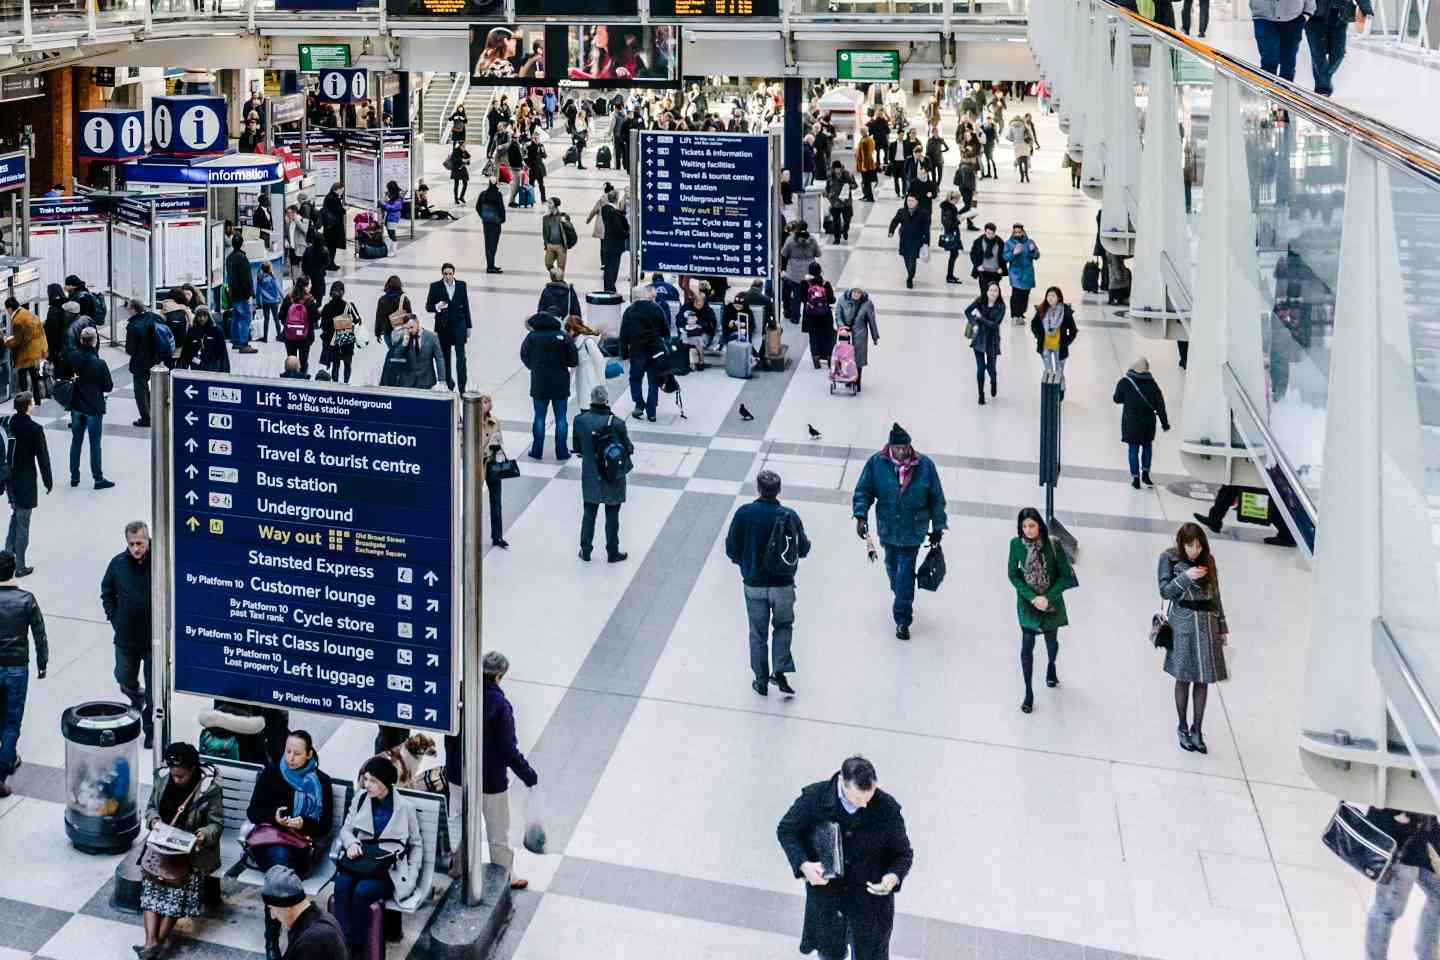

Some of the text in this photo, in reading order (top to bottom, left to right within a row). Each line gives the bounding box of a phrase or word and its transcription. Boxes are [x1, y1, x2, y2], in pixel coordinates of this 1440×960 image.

[680, 136, 692, 145] Lift
[681, 148, 705, 156] Tickets
[713, 149, 753, 158] information
[680, 160, 736, 169] Waiting facilities
[208, 167, 269, 183] information
[680, 171, 701, 179] Travel
[709, 173, 731, 181] tourist
[680, 182, 717, 191] Bus station
[160, 200, 191, 208] departures
[680, 194, 725, 203] Underground
[39, 205, 89, 215] Train Departures
[681, 207, 711, 215] Way out
[702, 218, 721, 227] Cycle
[675, 228, 690, 237] First
[691, 229, 710, 238] Class
[711, 230, 734, 239] lounge
[697, 241, 712, 249] Left
[713, 242, 740, 251] luggage
[723, 253, 740, 262] Taxis
[658, 262, 740, 274] Stansted Express tickets
[256, 391, 282, 408] Lift
[287, 392, 297, 401] To
[299, 393, 317, 404] Way
[337, 396, 392, 410] Underground
[287, 402, 350, 416] and Bus station
[258, 418, 417, 447] Tickets & information
[258, 445, 421, 475] Travel & tourist centre
[257, 471, 338, 494] Bus station
[257, 498, 353, 522] Underground
[258, 524, 322, 545] Way out
[367, 532, 385, 542] Broad
[385, 534, 406, 544] Street
[355, 546, 407, 559] Exchange Square
[248, 549, 375, 579] Stansted Express
[186, 573, 376, 607] By Platform 10 Customer lounge
[230, 598, 375, 633] By Platform 10 Cycle store
[230, 608, 284, 623] past Taxi rank
[185, 625, 375, 661] By Platform 10 First Class lounge
[223, 645, 375, 689] By Platform 10 Left luggage
[224, 656, 279, 674] Lost property
[272, 690, 375, 715] By Platform 10 Taxis
